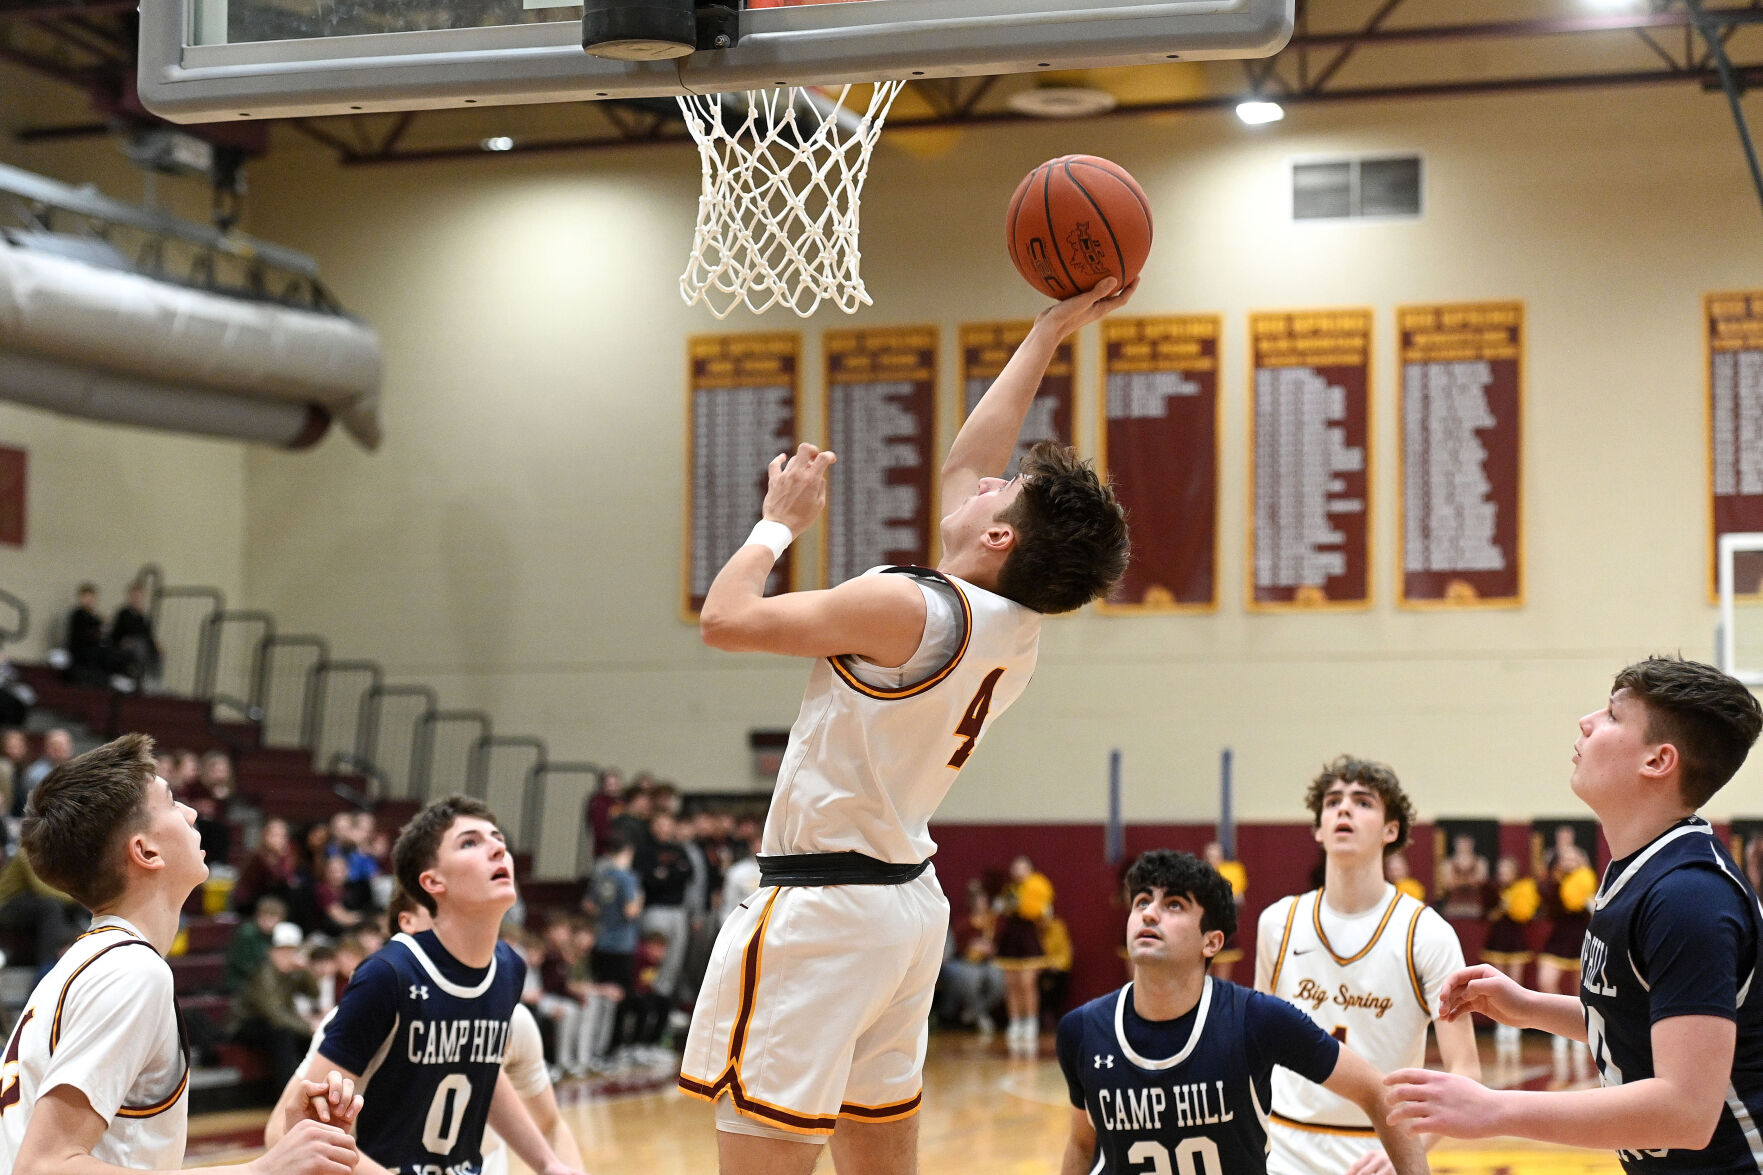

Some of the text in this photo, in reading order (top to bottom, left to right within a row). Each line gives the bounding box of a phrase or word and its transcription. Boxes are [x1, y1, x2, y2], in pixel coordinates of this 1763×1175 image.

[945, 666, 1008, 771] 4
[1293, 979, 1394, 1019] Big Spring
[408, 1019, 471, 1064] CAMP
[422, 1073, 472, 1156] 0
[1099, 1080, 1234, 1131] CAMP HILL
